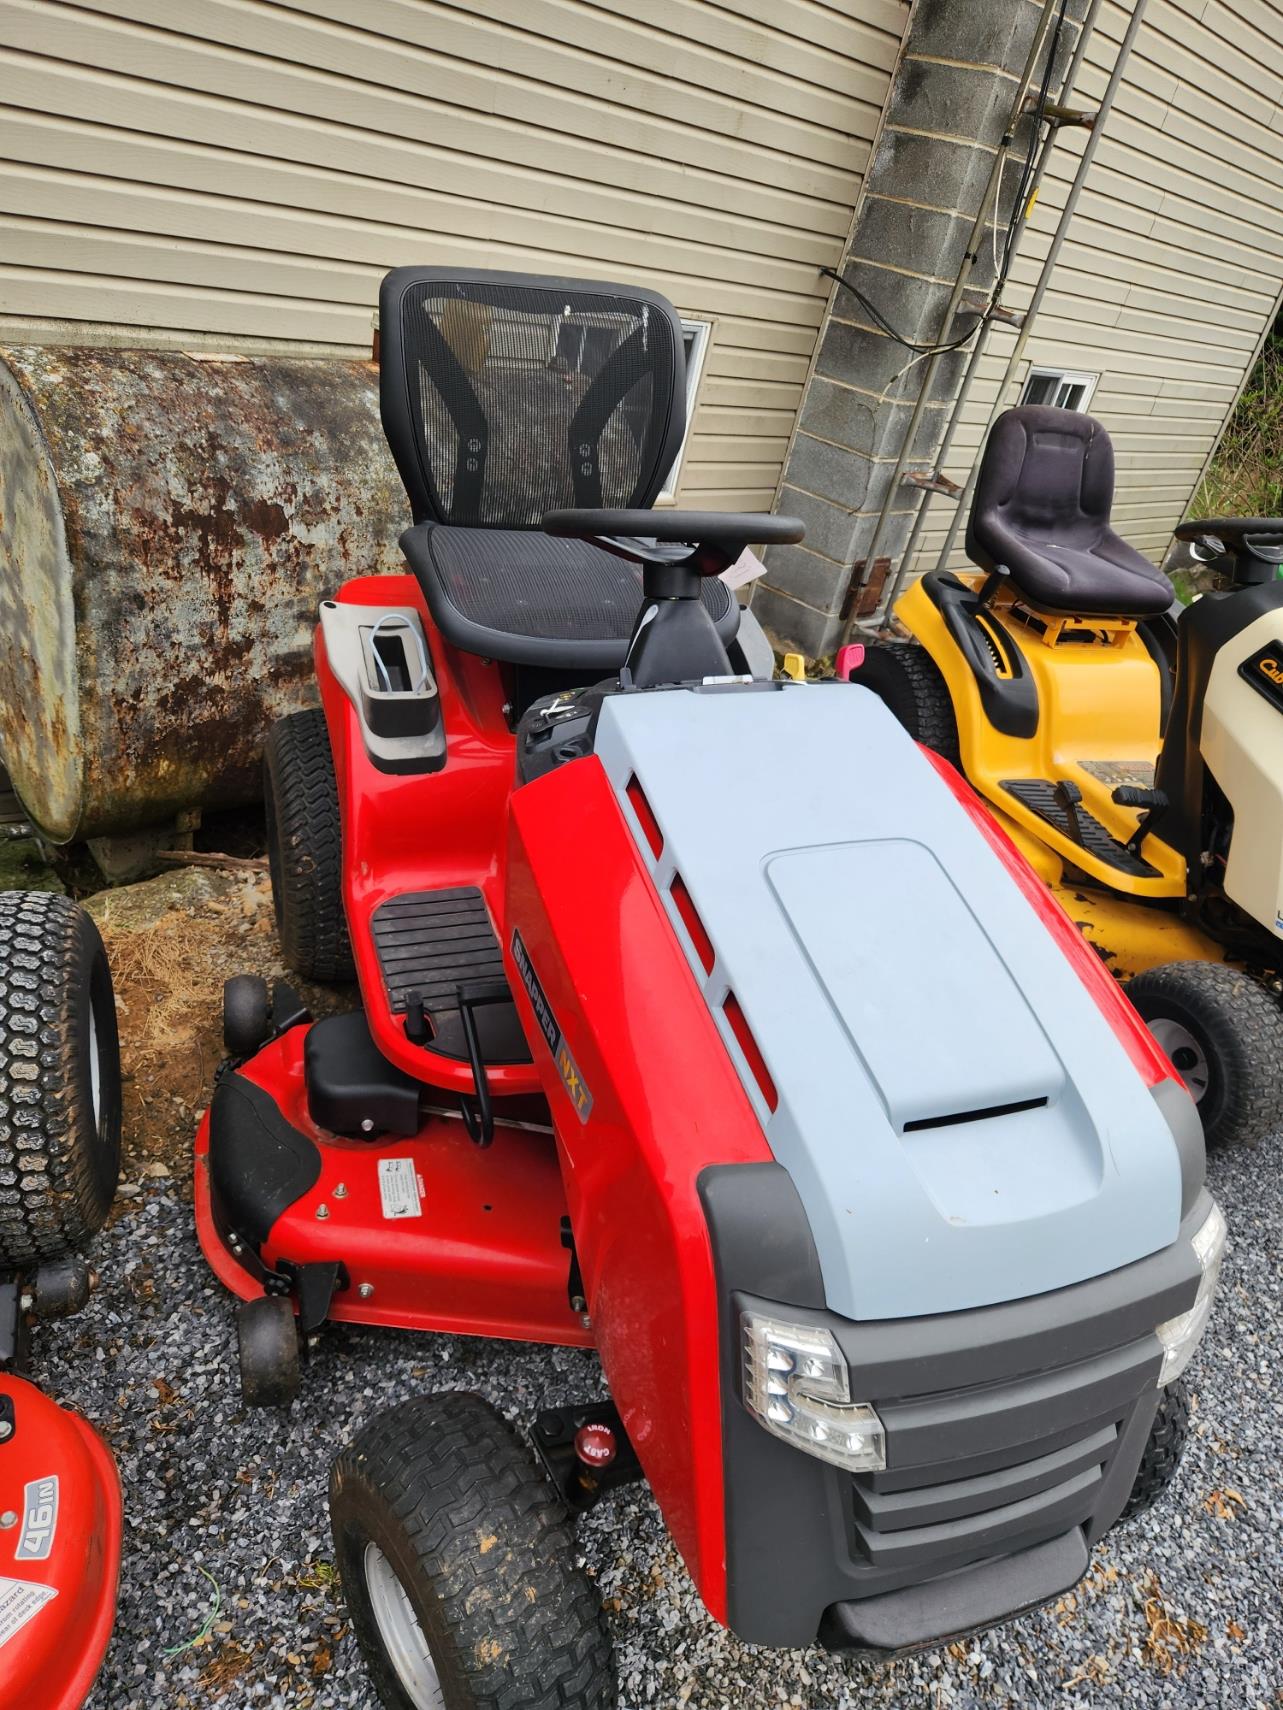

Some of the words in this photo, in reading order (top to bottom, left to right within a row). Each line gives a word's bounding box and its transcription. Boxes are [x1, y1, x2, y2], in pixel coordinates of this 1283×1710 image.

[513, 938, 556, 1047] SNAPPER
[560, 1050, 588, 1110] NXT
[587, 1424, 611, 1435] IRON
[583, 1445, 610, 1459] CAST
[0, 1586, 24, 1613] azard
